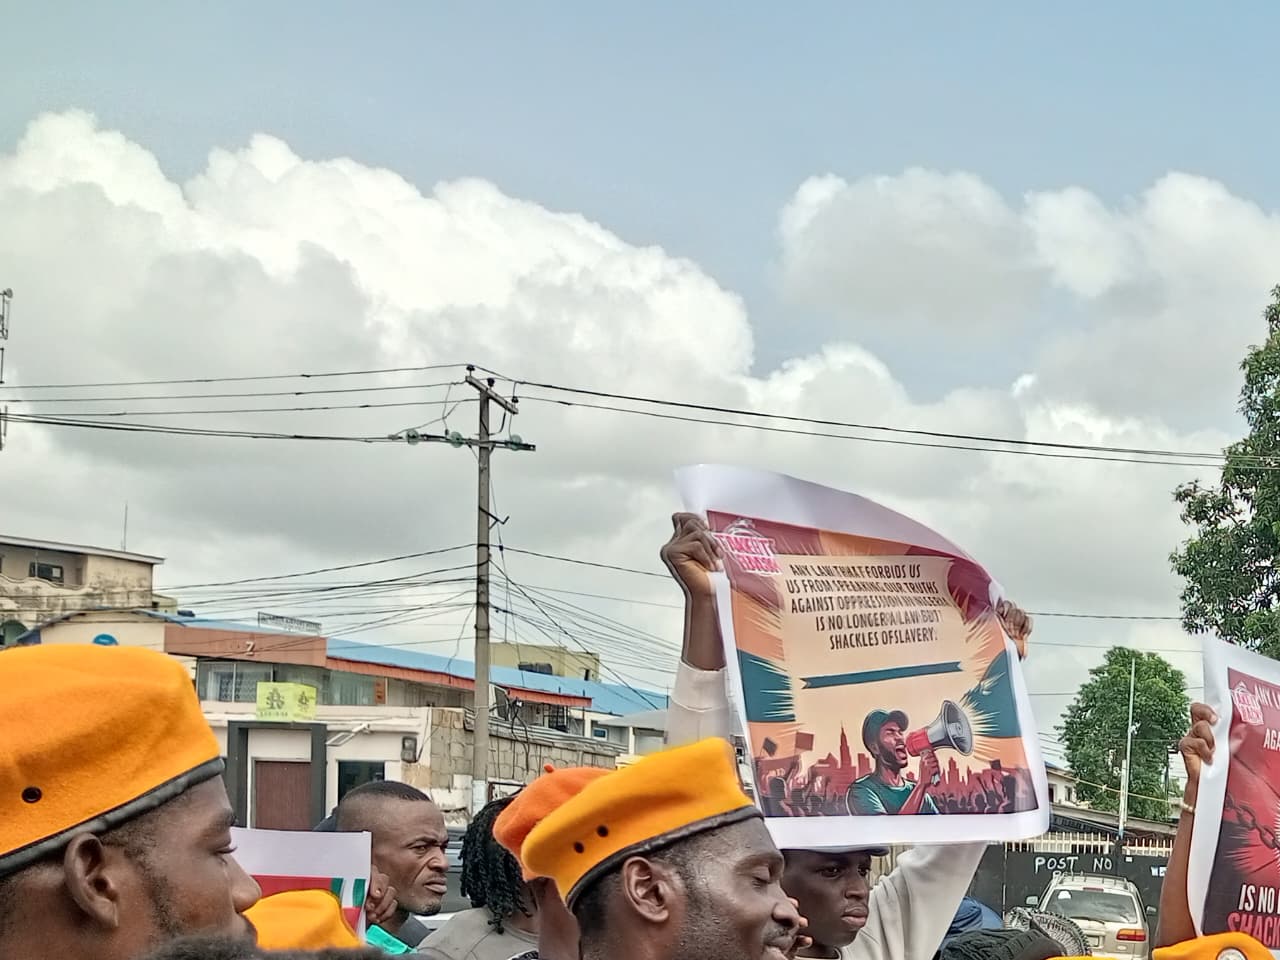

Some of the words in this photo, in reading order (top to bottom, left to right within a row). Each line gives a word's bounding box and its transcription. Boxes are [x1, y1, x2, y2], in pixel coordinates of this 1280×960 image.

[865, 564, 906, 579] FORBIDS
[909, 564, 921, 578] US
[785, 580, 800, 593] US
[802, 580, 833, 593] FROM
[904, 581, 939, 594] TRUTHS
[791, 596, 835, 614] AGAINST
[816, 616, 825, 631] IS
[828, 615, 843, 631] NO
[830, 631, 879, 650] SHACKLES
[1035, 856, 1079, 875] POST
[1093, 857, 1112, 872] NO
[1238, 884, 1256, 911] IS
[1258, 886, 1275, 914] NO
